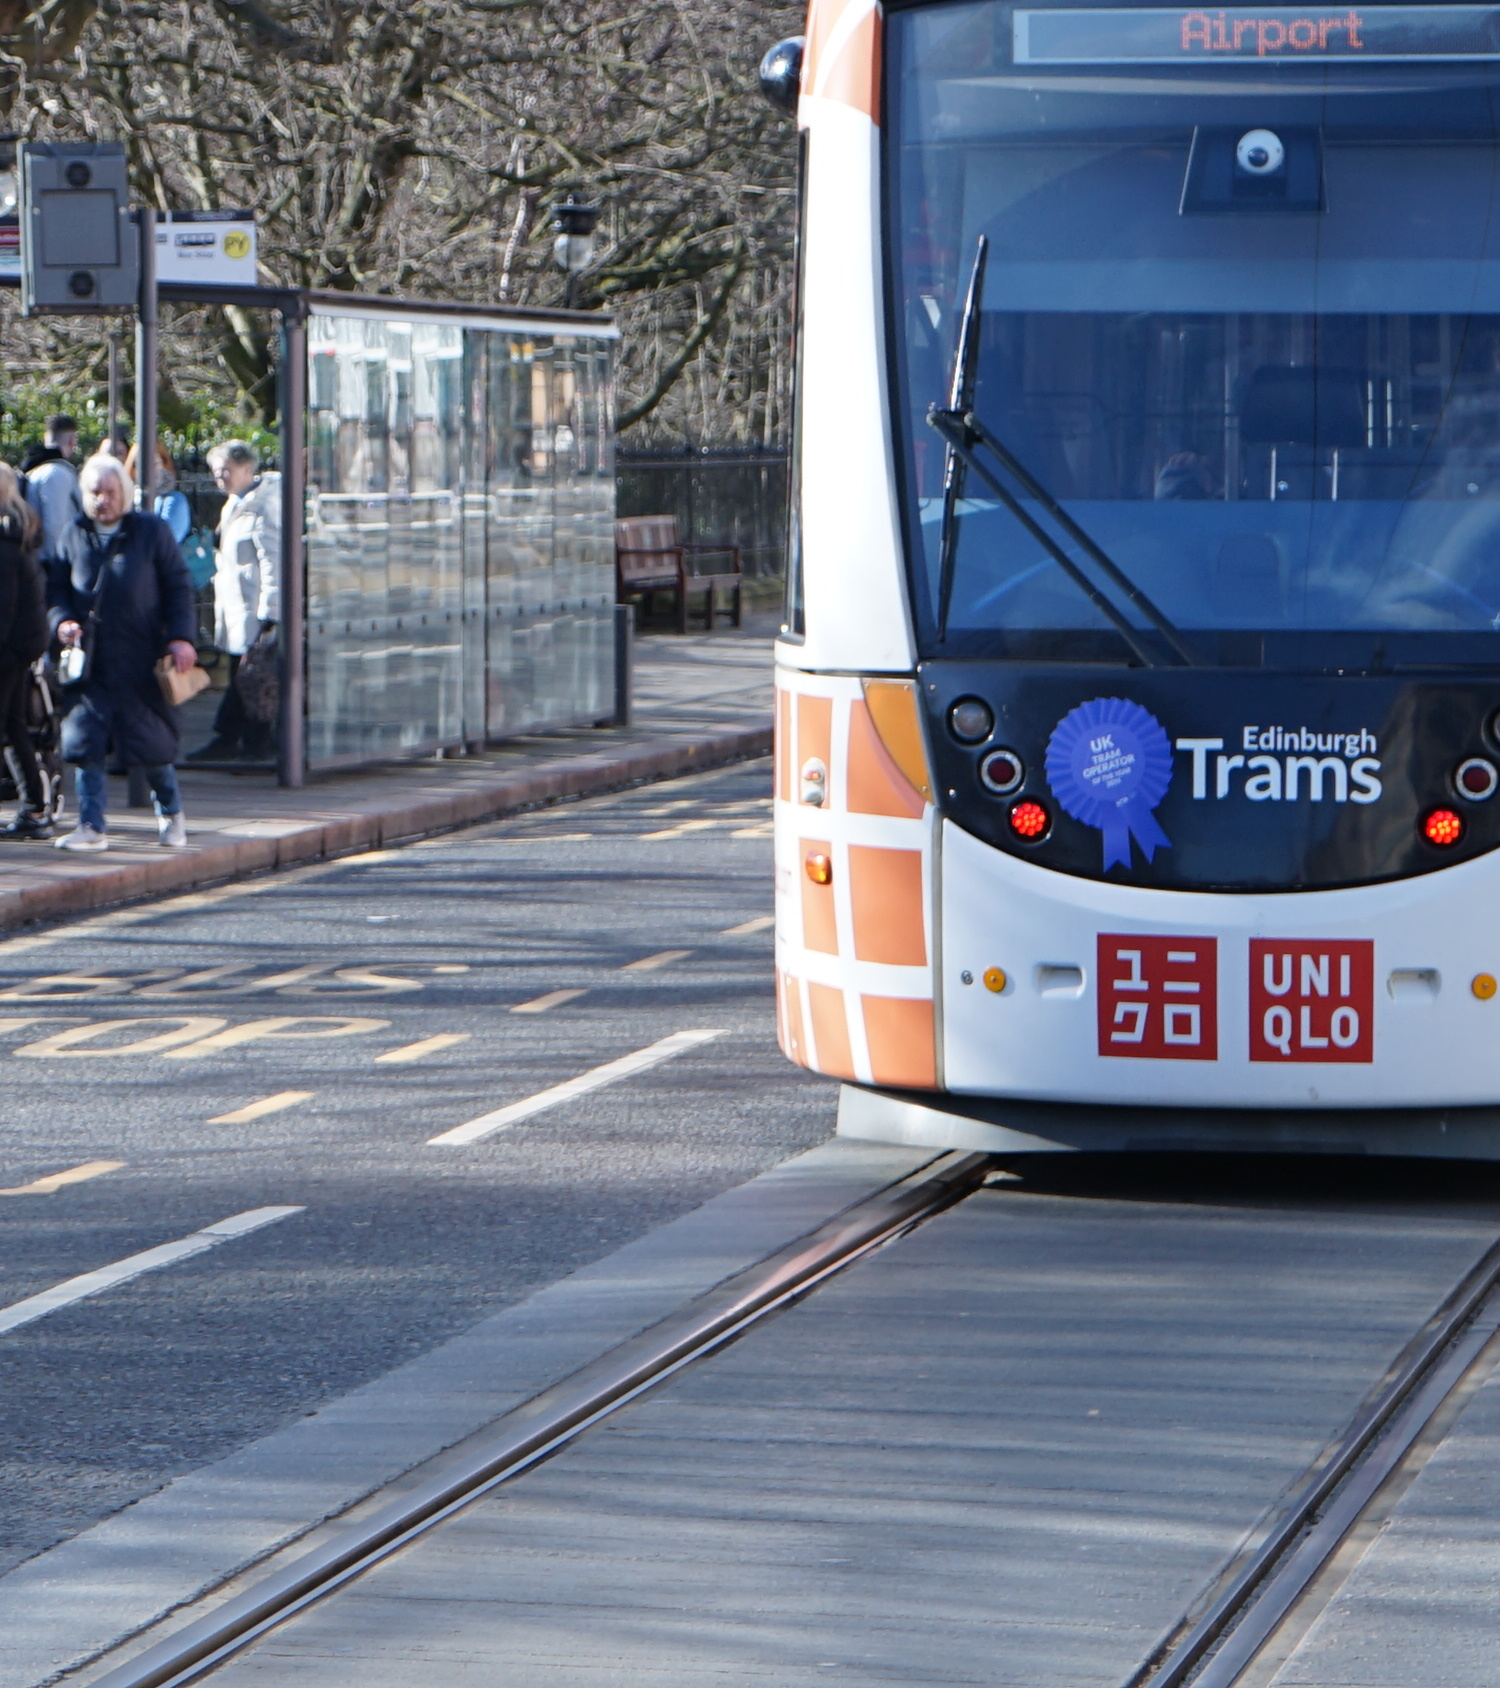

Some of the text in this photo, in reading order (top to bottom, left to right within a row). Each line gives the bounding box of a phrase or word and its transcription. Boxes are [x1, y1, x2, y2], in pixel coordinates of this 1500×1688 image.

[1179, 11, 1365, 57] Airport
[1090, 734, 1114, 753] UK
[1091, 748, 1122, 765] TRAM
[1243, 725, 1377, 758] Edinburgh
[1082, 754, 1136, 779] OPERATOR
[1175, 737, 1383, 805] Trams
[1263, 953, 1351, 997] UNI
[1263, 1005, 1359, 1055] QLO
